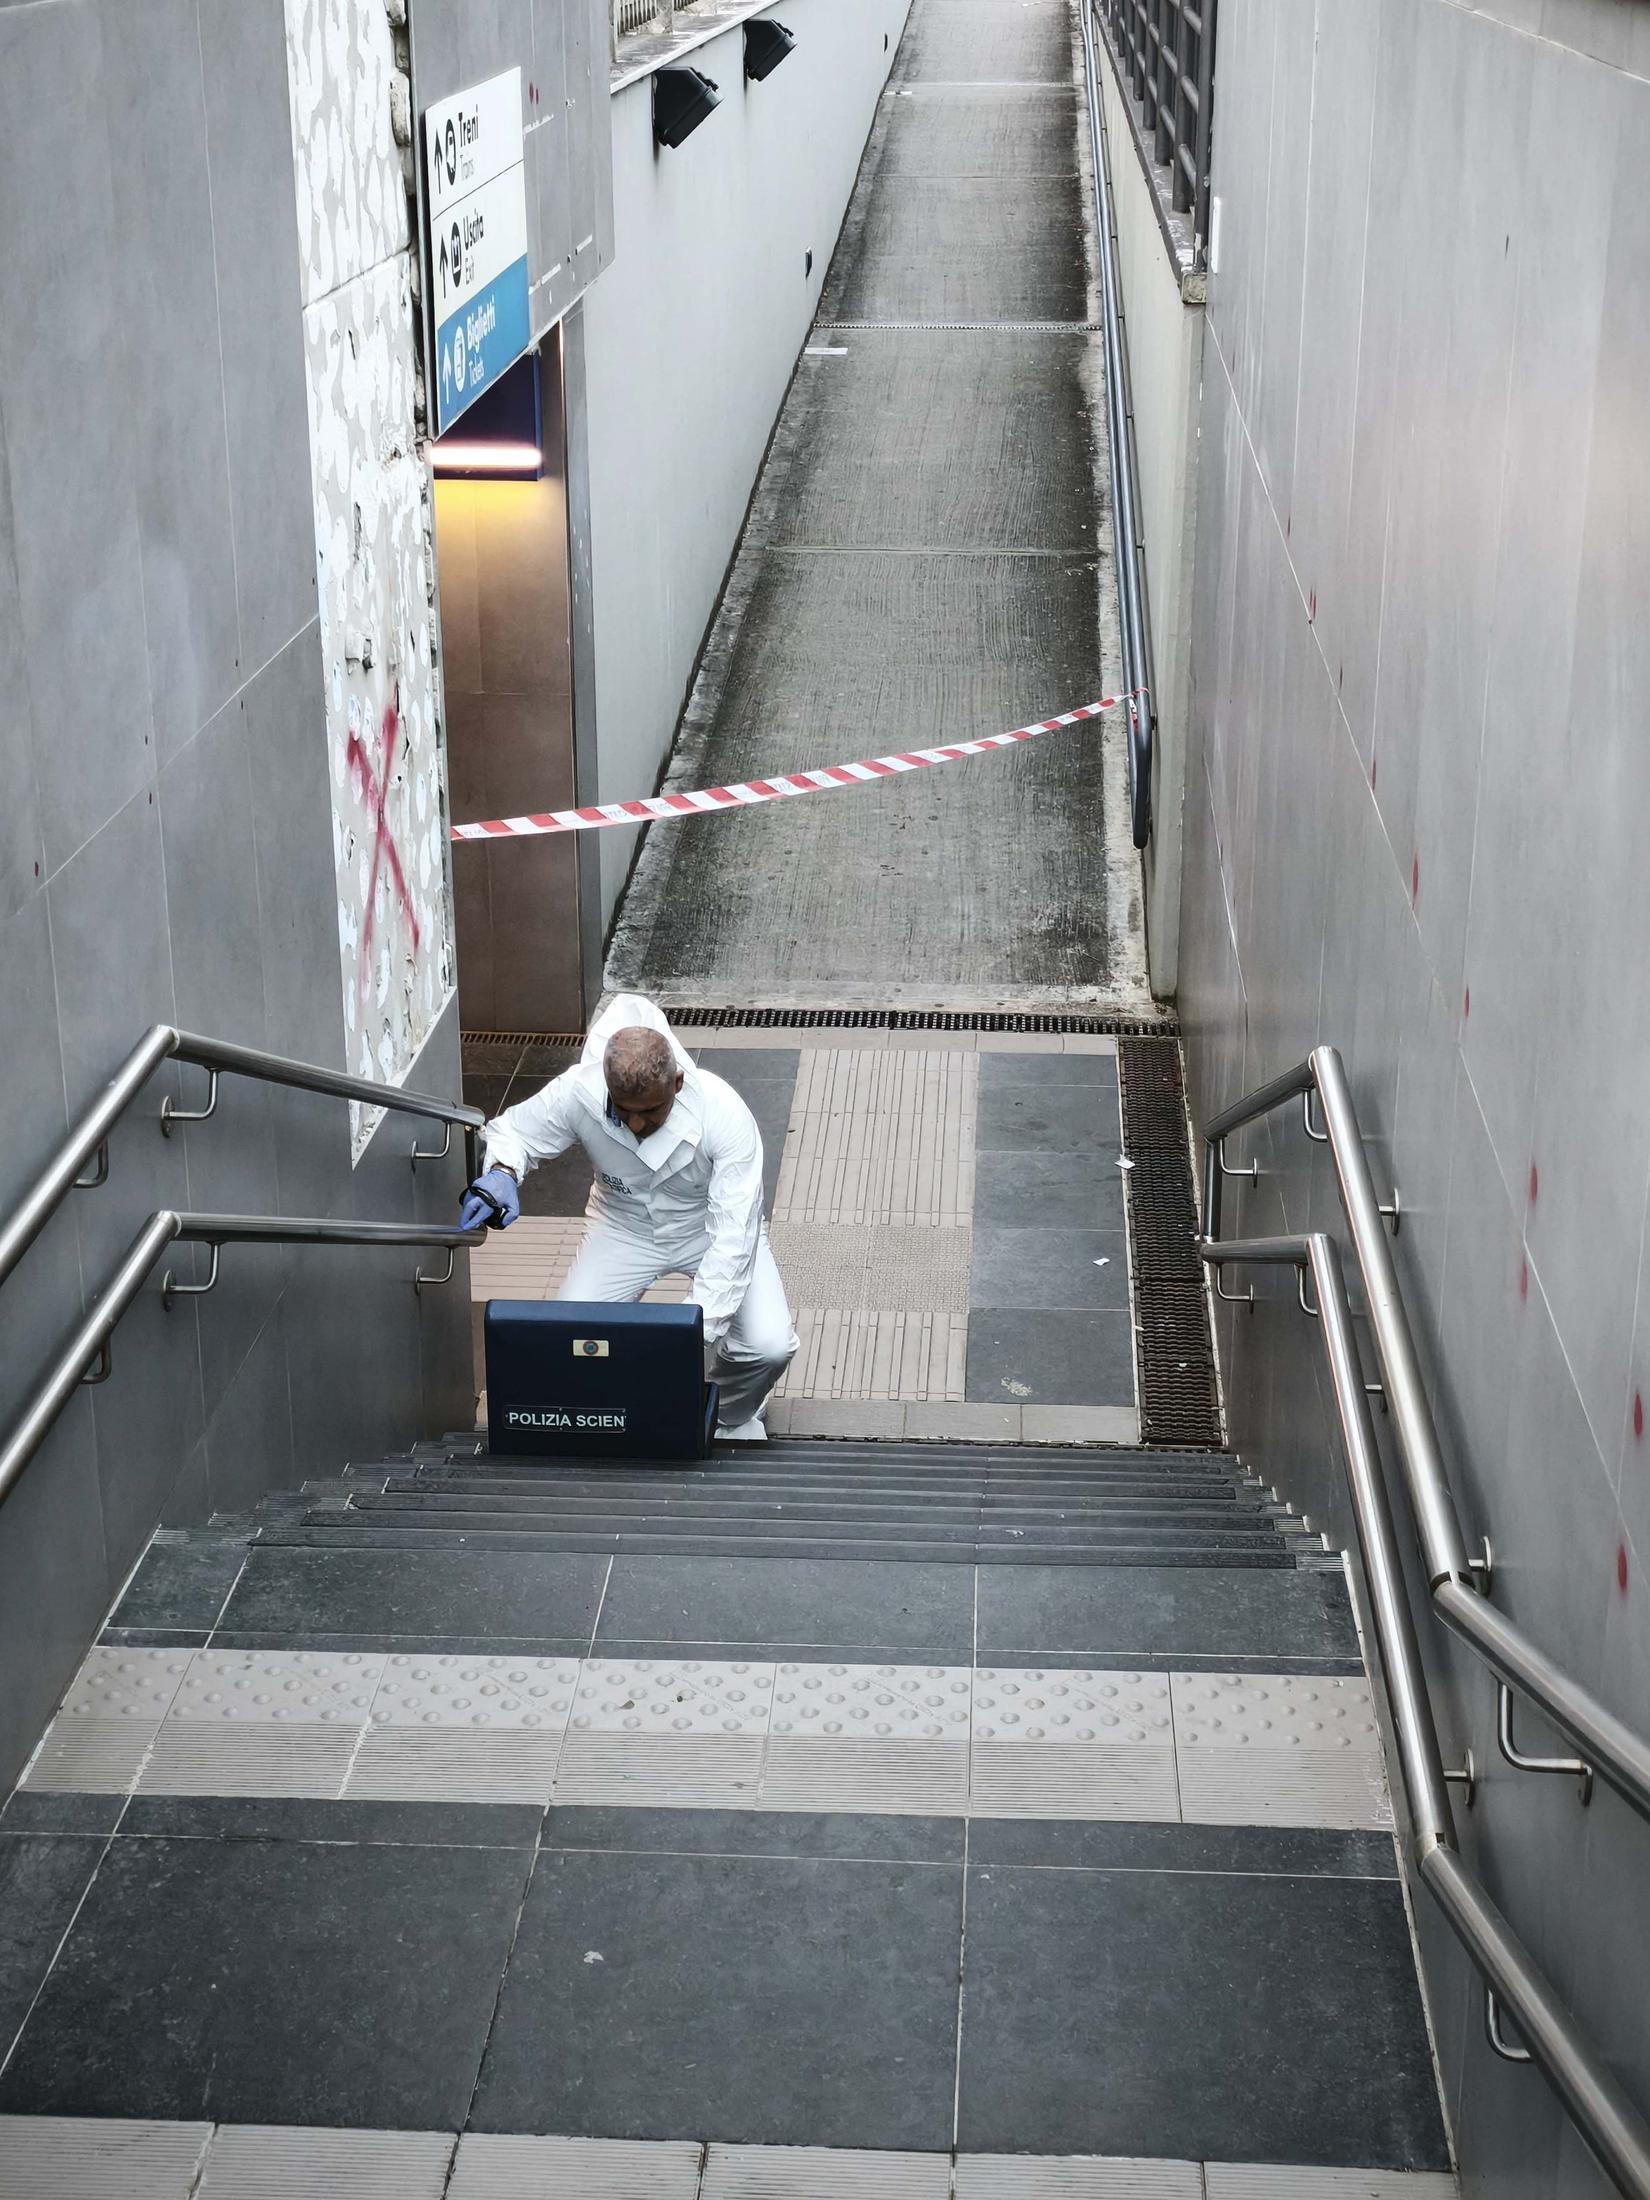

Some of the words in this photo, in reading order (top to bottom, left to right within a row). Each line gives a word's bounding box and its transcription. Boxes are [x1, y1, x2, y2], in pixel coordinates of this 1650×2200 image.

[458, 103, 478, 148] Treni
[463, 207, 484, 251] Uscita
[467, 294, 496, 354] Biglietti
[509, 1411, 572, 1427] POLIZIA
[576, 1414, 626, 1428] SCIEN
